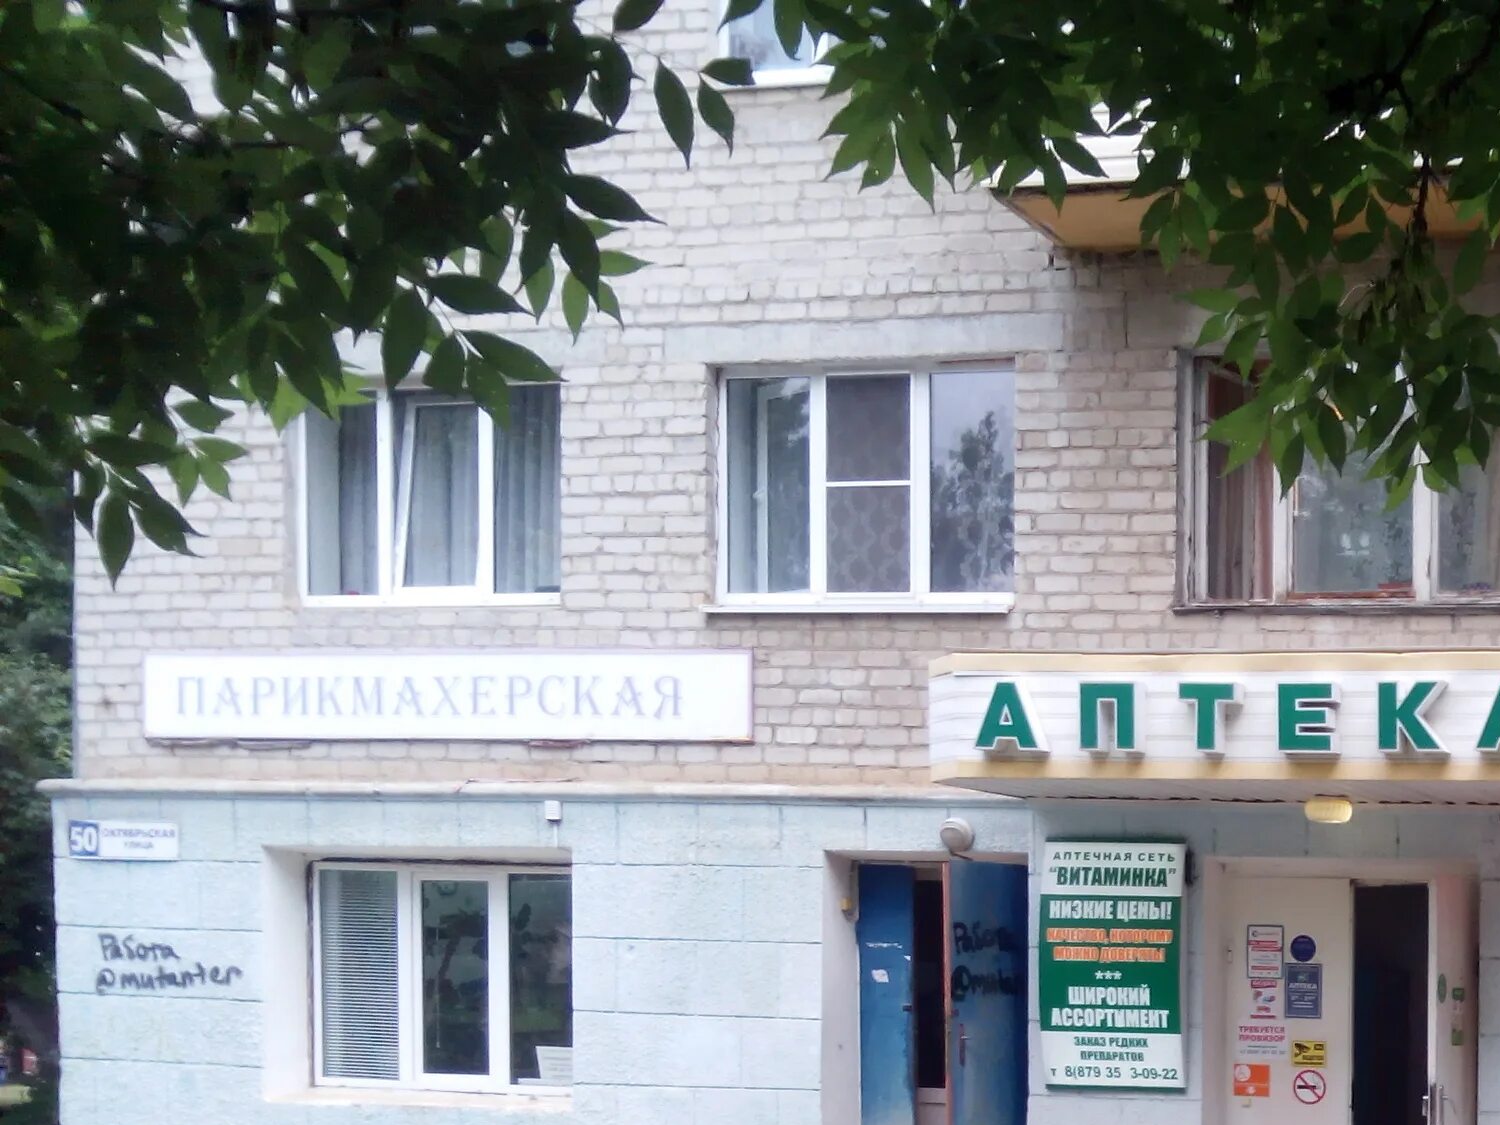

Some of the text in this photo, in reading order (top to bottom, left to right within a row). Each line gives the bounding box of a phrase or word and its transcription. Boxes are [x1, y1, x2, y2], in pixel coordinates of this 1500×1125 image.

[175, 675, 686, 721] ПАРИКМАХЕРСКАЯ
[69, 826, 98, 852] 50
[1053, 851, 1176, 862] АПТЕЧНАЯ СЕТЬ
[1049, 900, 1173, 922] НИЗКИЕ ЦЕНЫ!
[1053, 946, 1100, 962] МОЖНО
[1068, 984, 1151, 1006] ШИРОКИЙ
[1051, 1007, 1170, 1028] АССОРТИМЕНТ
[1073, 1036, 1149, 1048] ЗАКАЗ РЕДКИХ
[1080, 1050, 1145, 1062] ПРЕПАРАТОВ
[1106, 1067, 1122, 1079] 35
[1130, 1067, 1179, 1080] 3-09-22
